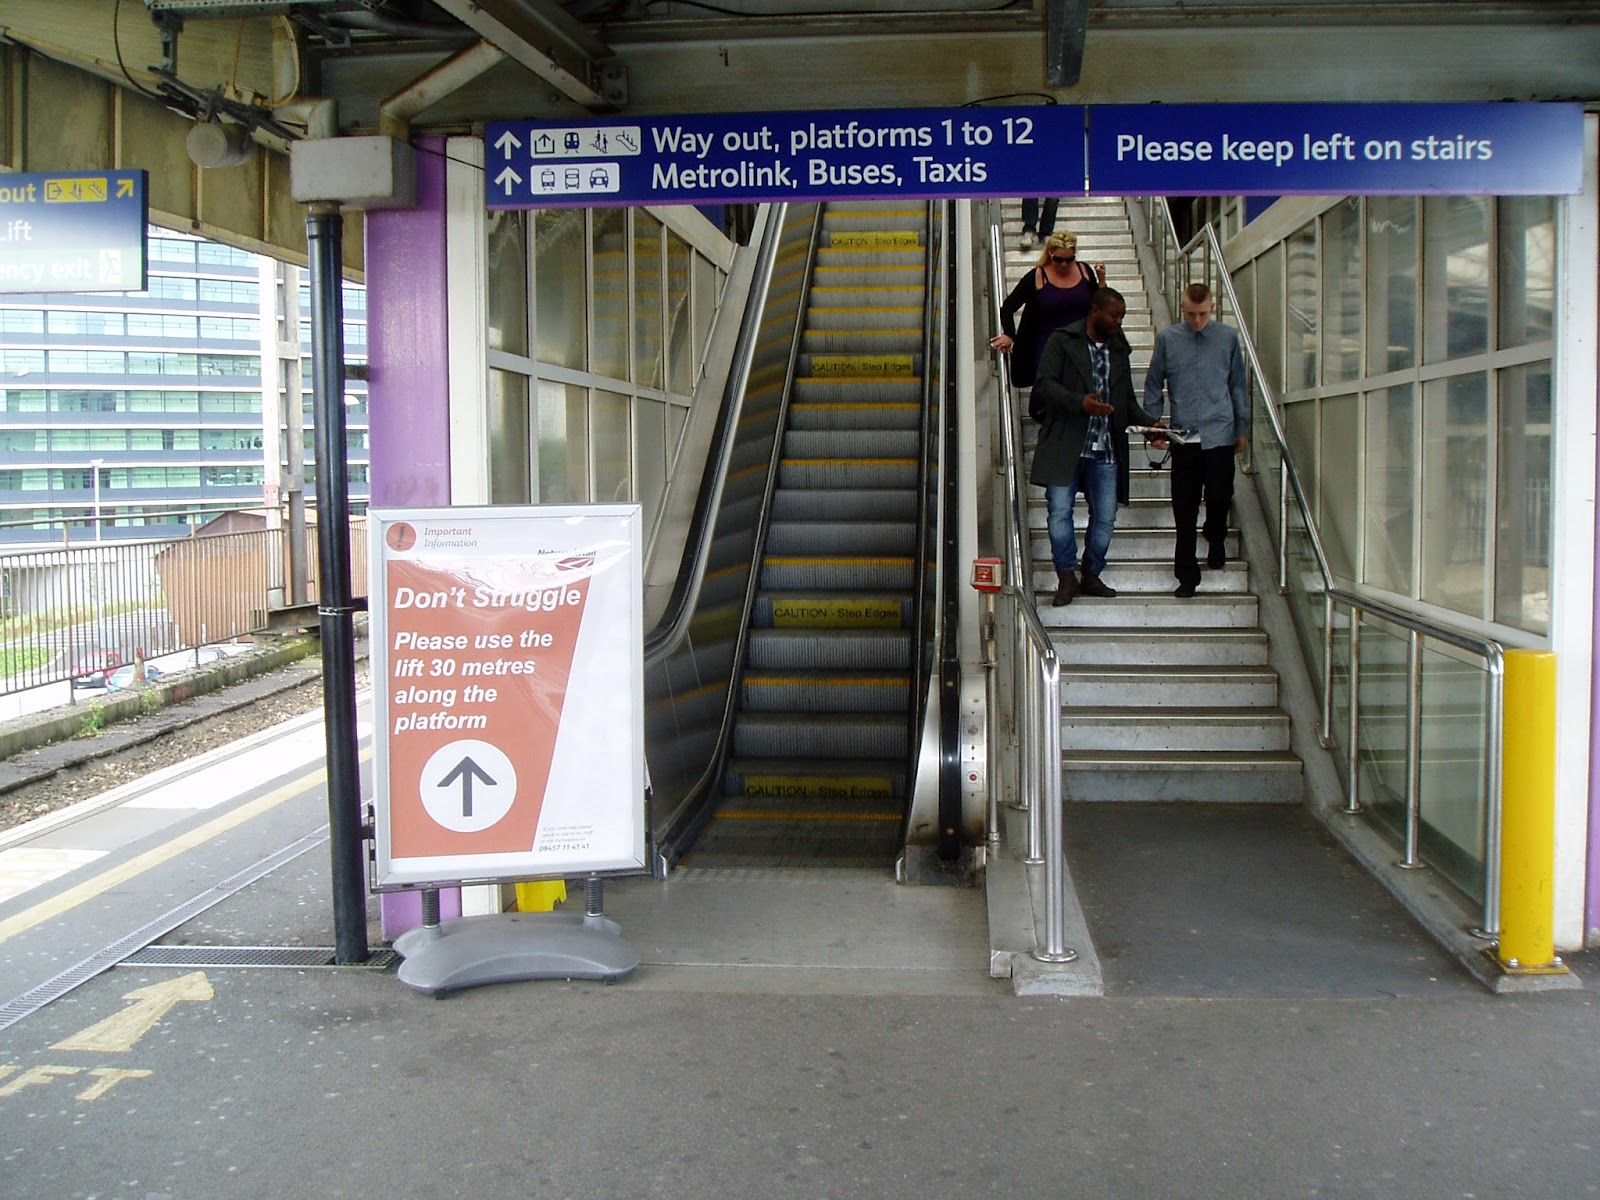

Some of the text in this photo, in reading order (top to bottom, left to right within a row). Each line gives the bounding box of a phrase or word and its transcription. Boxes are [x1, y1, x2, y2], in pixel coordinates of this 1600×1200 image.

[651, 117, 1034, 158] Way out, platforms 1 to 12
[1117, 133, 1492, 167] Please keep left on stairs
[651, 156, 988, 190] Metrolink, Buses, Taxis
[0, 183, 37, 204] out
[51, 257, 93, 279] exit
[812, 362, 855, 371] CAUTION
[862, 362, 882, 372] Step
[884, 362, 911, 373] Edges
[424, 527, 472, 537] Important
[424, 539, 477, 549] Information
[394, 585, 581, 612] Don't Struggle
[774, 608, 827, 618] CAUTION
[837, 608, 862, 619] Step
[865, 608, 899, 620] Edges
[394, 630, 553, 651] Please use the
[394, 658, 536, 677] lift 30 metres
[394, 684, 497, 707] along the
[394, 711, 487, 735] platform
[746, 785, 807, 797] CAUTION
[819, 786, 847, 798] Step
[851, 786, 890, 799] Edges
